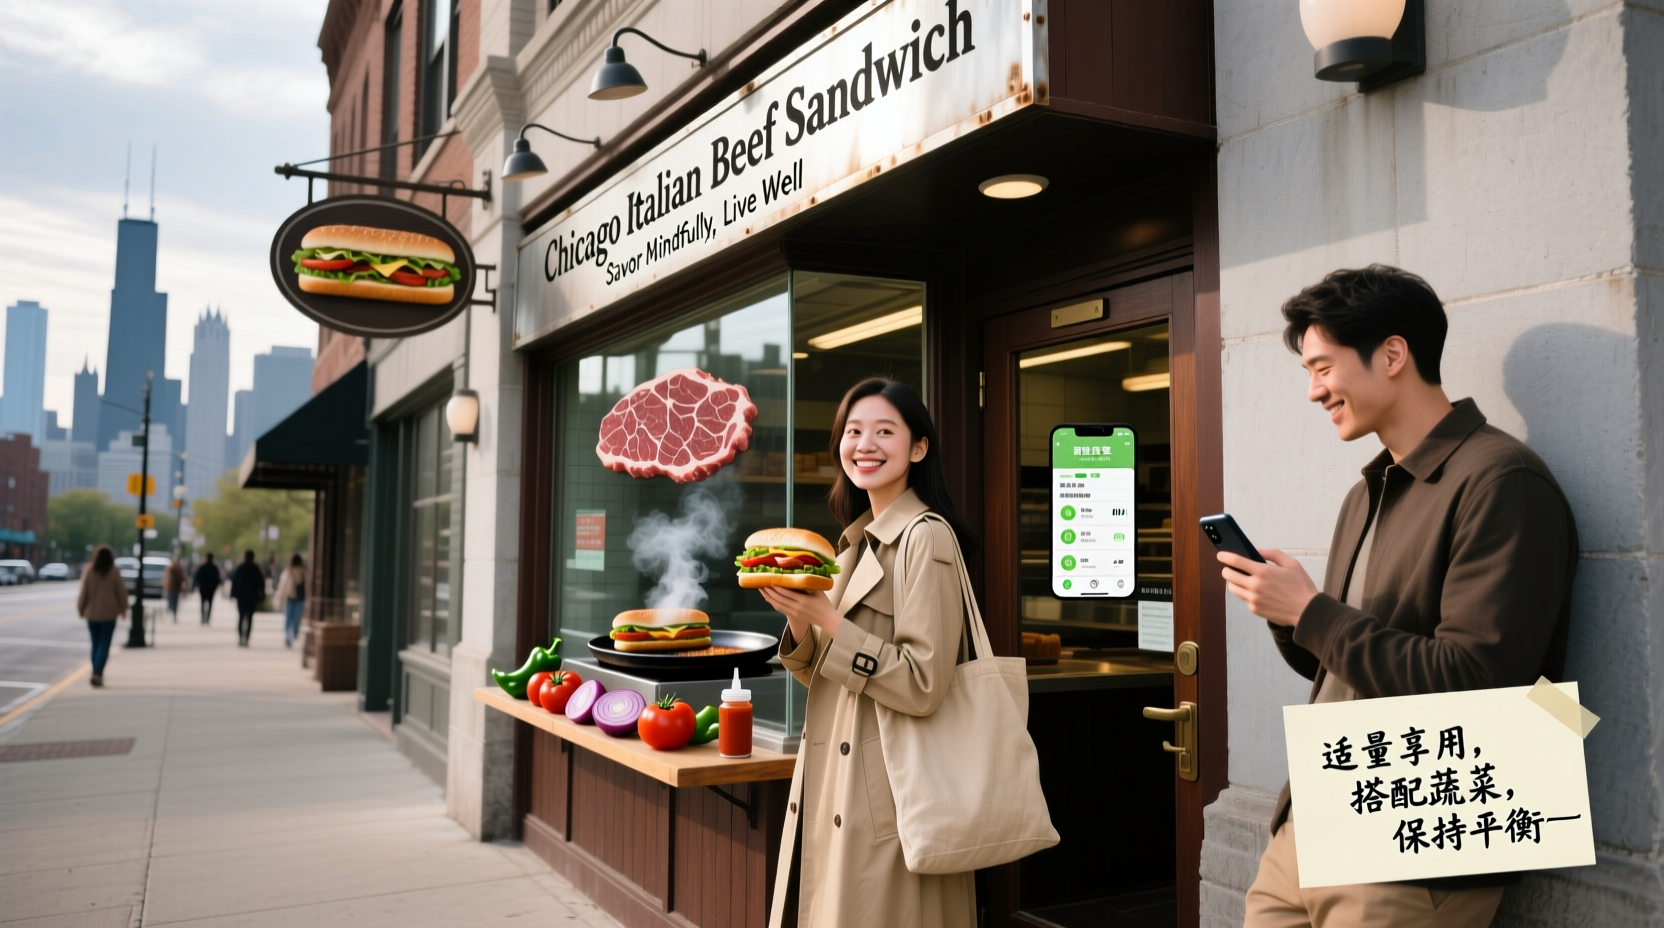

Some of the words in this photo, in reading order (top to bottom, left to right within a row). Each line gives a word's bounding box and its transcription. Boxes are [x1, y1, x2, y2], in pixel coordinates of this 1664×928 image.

[544, 215, 621, 282] Chicago
[627, 165, 702, 236] Italian
[711, 100, 779, 190] Beef
[785, 0, 976, 147] Sandwich
[606, 253, 643, 286] Savor
[646, 211, 717, 266] Mindfully,
[723, 193, 757, 226] Live
[762, 158, 803, 205] Well
[1322, 725, 1481, 771] 适量享用，
[1350, 763, 1514, 815] 搭配蔬菜，
